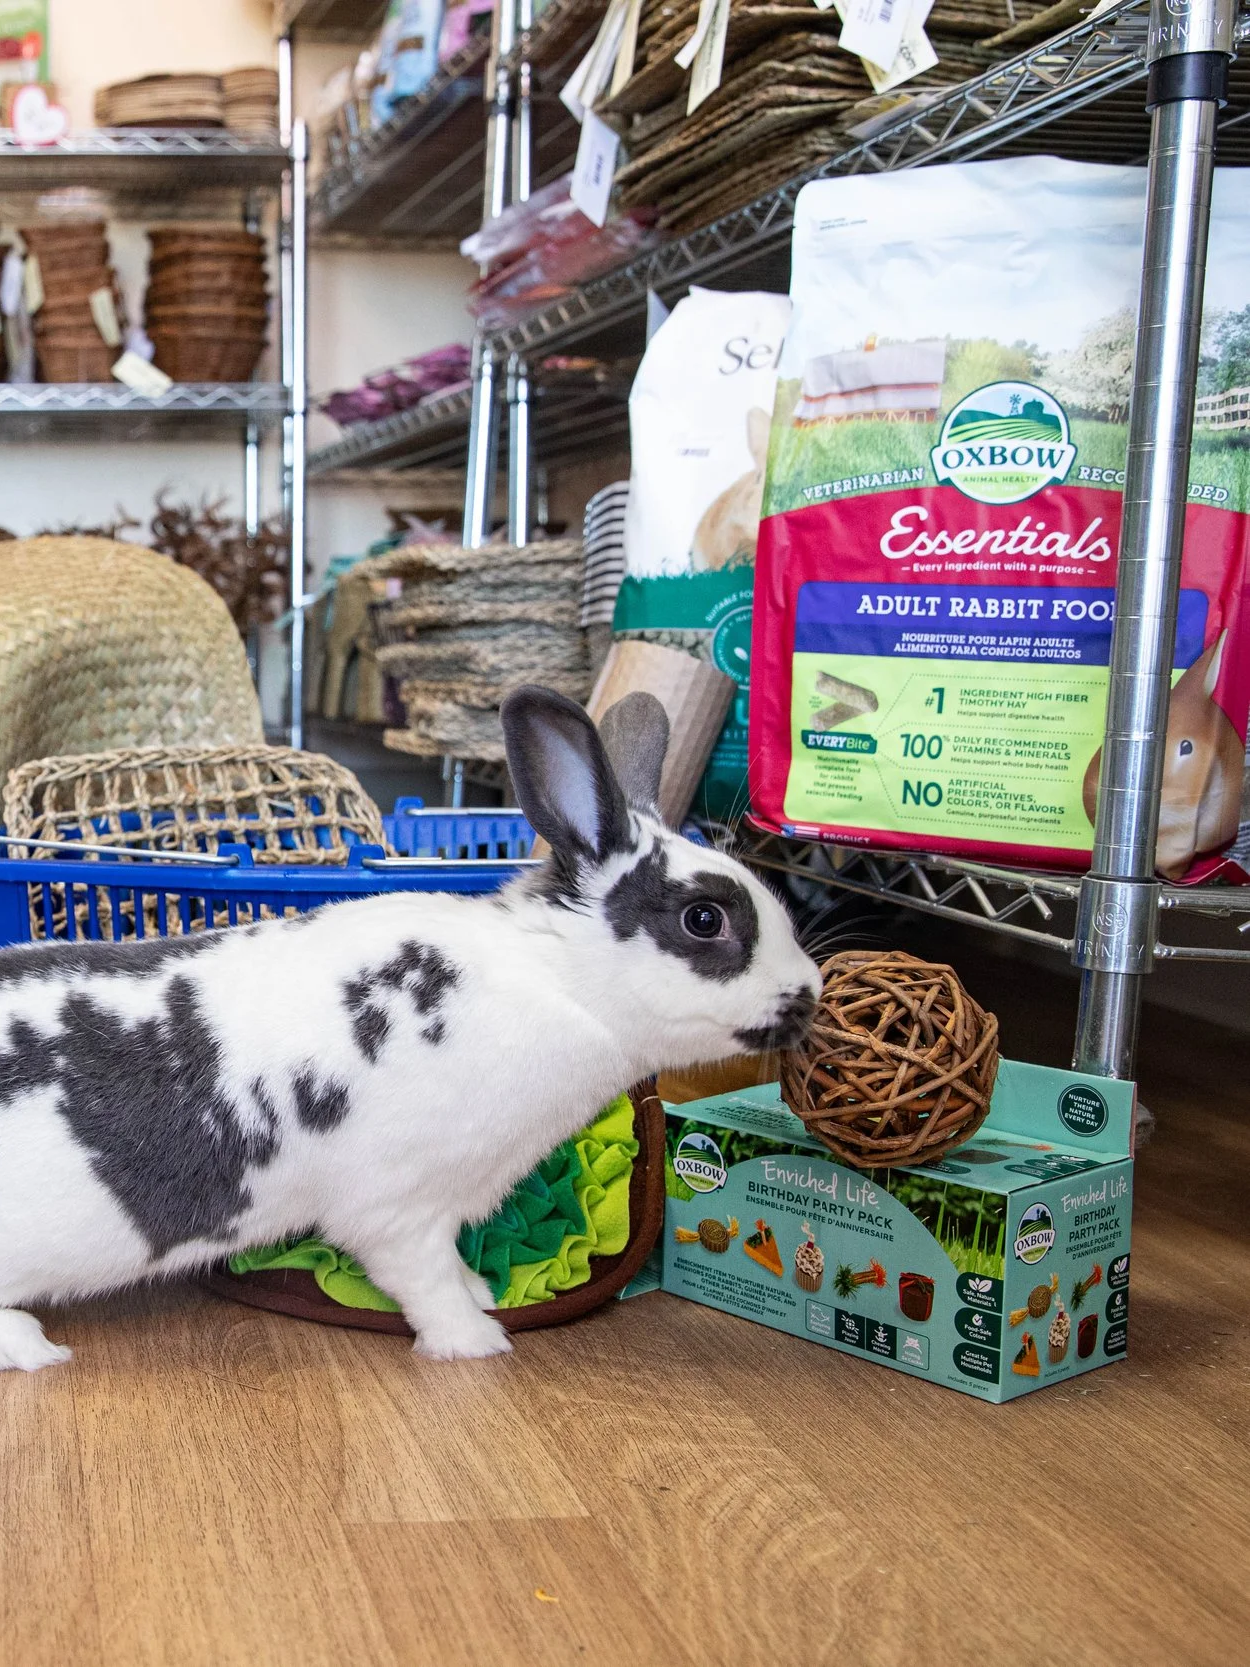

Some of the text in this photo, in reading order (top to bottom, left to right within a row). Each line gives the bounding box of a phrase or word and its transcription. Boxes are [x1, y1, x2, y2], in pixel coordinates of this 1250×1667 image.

[942, 446, 1065, 469] OXBOW
[803, 467, 923, 499] VETERINARIAN
[963, 475, 1038, 484] ANIMAL HEALTH
[880, 504, 1111, 562] Essentials
[913, 562, 942, 573] Every
[945, 561, 1001, 572] ingredient
[1004, 562, 1026, 571] with
[1039, 565, 1083, 575] purpose
[856, 595, 941, 616] ADULT
[949, 598, 1043, 620] RABBIT
[902, 633, 1074, 648] NOURRITURE POUR LAPIN ADULTE
[894, 643, 1081, 659] ALIMENTO PARA CONEJOS ADULTOS
[960, 689, 1024, 699] INGREDIENT
[1026, 692, 1052, 700] HIGH
[1056, 694, 1088, 703] FIBER
[960, 698, 1027, 709] TIMOTHY HAY
[979, 711, 1065, 722] support digestive health
[954, 736, 981, 744] DAILY
[985, 738, 1068, 750] RECOMMENDED
[952, 745, 1071, 760] VITAMINS & MINERALS
[951, 756, 970, 764] Helps
[1026, 762, 1043, 770] body
[1045, 763, 1068, 771] health
[902, 779, 1005, 807] NO ARTIFICIAL
[948, 789, 1036, 803] PRESERVATIVES,
[947, 797, 1065, 815] COLORS, OR FLAVORS
[979, 811, 1017, 821] purposeful
[1019, 815, 1061, 825] ingredients
[823, 832, 870, 843] PRODUCT
[1068, 1094, 1100, 1108] NURTURE
[1073, 1102, 1093, 1112] THEIR
[1064, 1113, 1099, 1127] EVERY DAY
[1069, 1107, 1096, 1120] NATURE
[677, 1159, 724, 1182] OXBOW
[761, 1160, 878, 1207] Enriched Life
[1061, 1176, 1128, 1213] Enriched Life
[748, 1181, 893, 1230] BIRTHDAY PARTY PACK
[746, 1195, 894, 1242] ENSEMBLE POUR FÊTE D'ANNIVERSAIRE
[1074, 1205, 1116, 1227] BIRTHDAY
[1069, 1217, 1120, 1242] PARTY PACK
[1016, 1232, 1053, 1252] OXBOW
[1065, 1236, 1109, 1254] ENSEMBLE POUR
[1072, 1242, 1115, 1260] D'ANNIVERSAIRE
[674, 1262, 704, 1277] BEHAVIORS
[705, 1272, 716, 1281] FOR
[744, 1285, 766, 1297] GUINEA
[784, 1298, 796, 1307] AND
[677, 1257, 713, 1272] ENRICHMENT
[714, 1268, 727, 1277] ITEM
[736, 1275, 765, 1290] NURTURE
[766, 1285, 792, 1299] NATURAL
[701, 1278, 766, 1304] OTHER SMALL ANIMALS
[967, 1296, 991, 1307] Materials
[964, 1324, 992, 1336] Food-Safe
[968, 1331, 986, 1341] Colors
[960, 1354, 992, 1368] Multiple Pet
[965, 1350, 980, 1359] Great
[960, 1361, 992, 1374] Households
